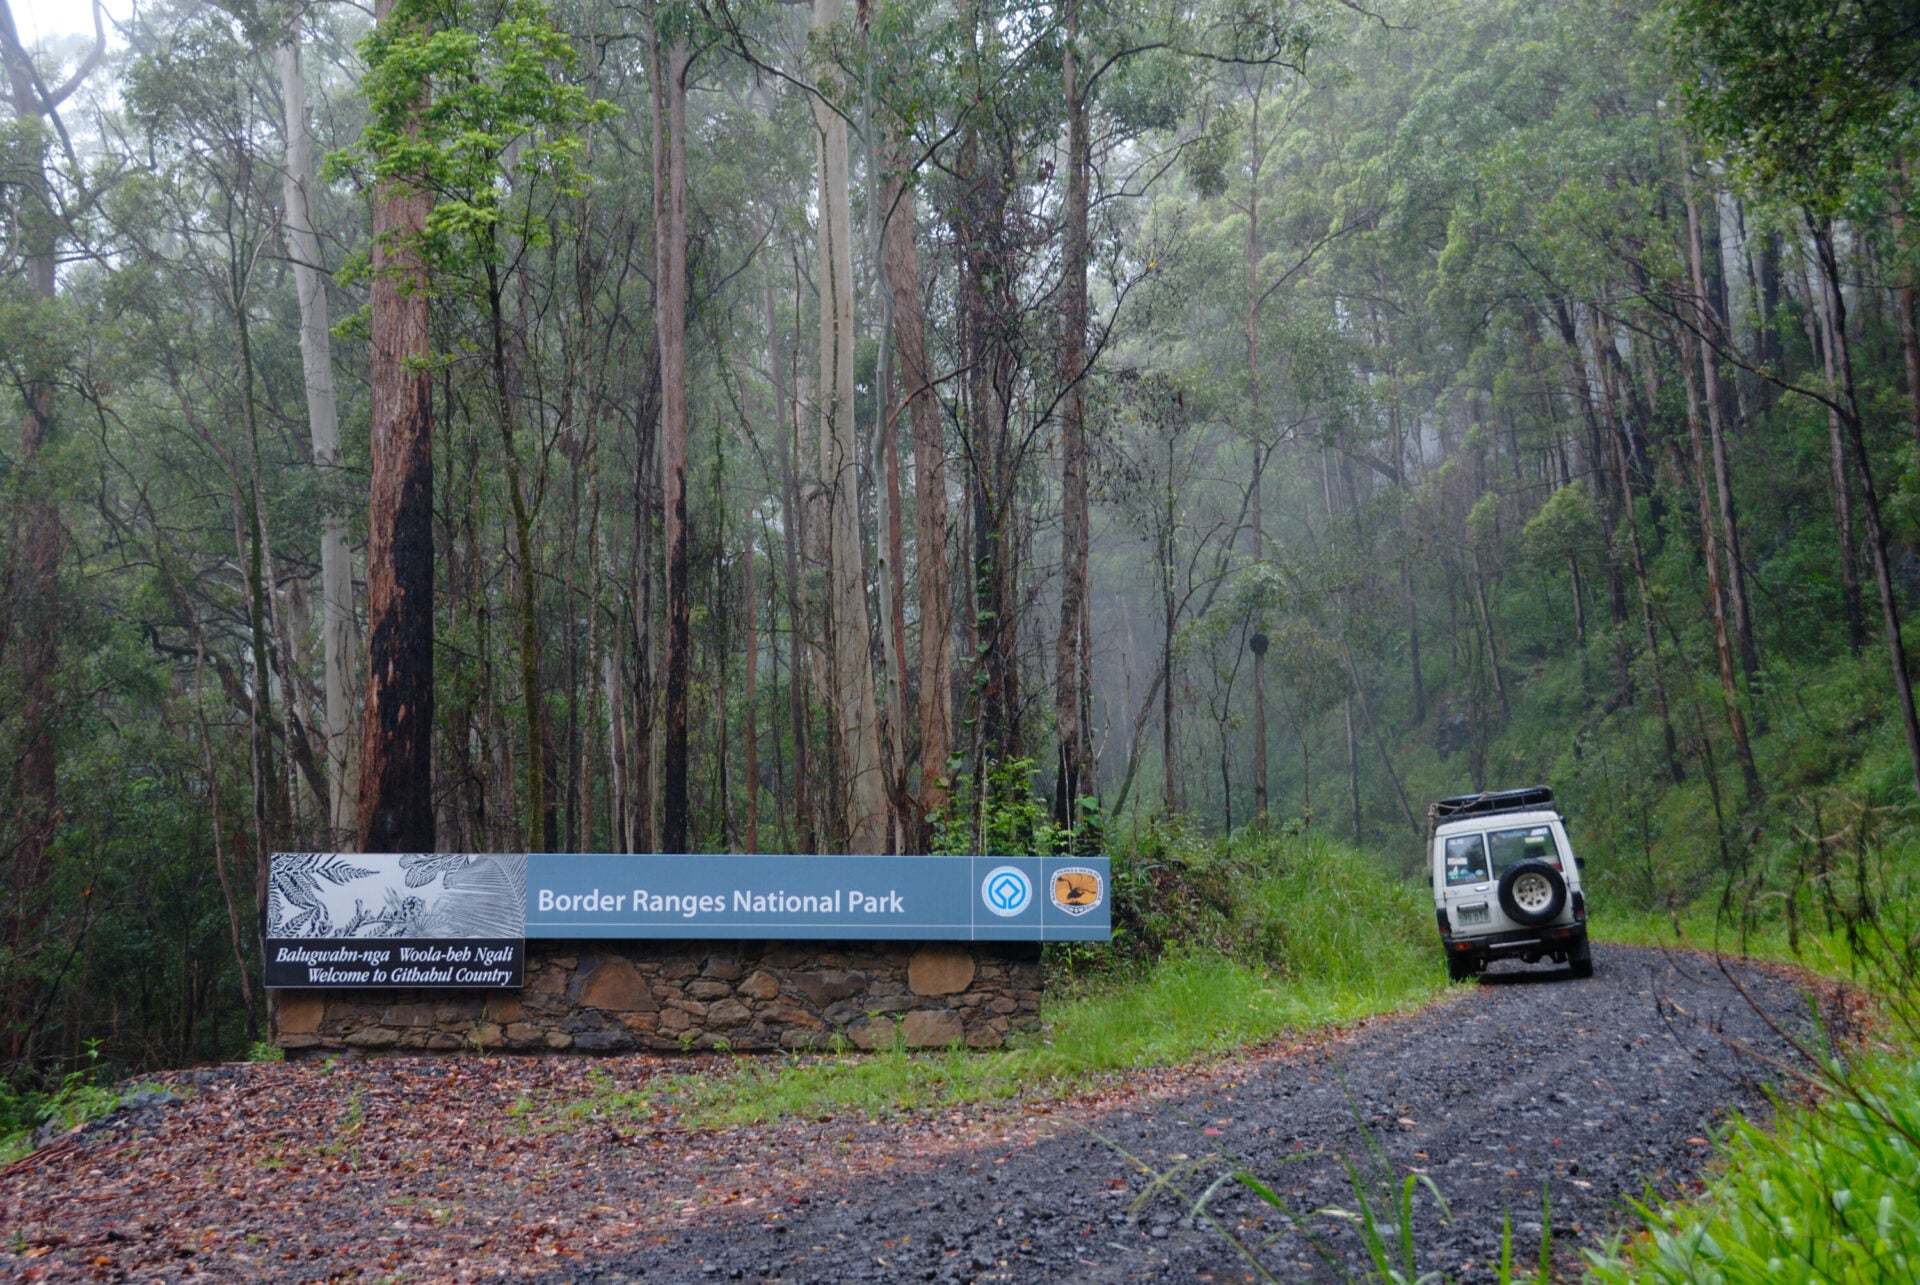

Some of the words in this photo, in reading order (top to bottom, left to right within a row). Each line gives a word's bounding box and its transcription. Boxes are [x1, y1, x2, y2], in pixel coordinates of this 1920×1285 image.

[538, 889, 626, 912] Border
[632, 889, 726, 918] Ranges
[733, 890, 841, 913] National
[848, 890, 905, 913] Park
[474, 946, 514, 966] Ngali
[308, 967, 370, 983] Welcome
[373, 969, 388, 983] to
[390, 967, 454, 983] Githabul
[455, 967, 513, 986] Country
